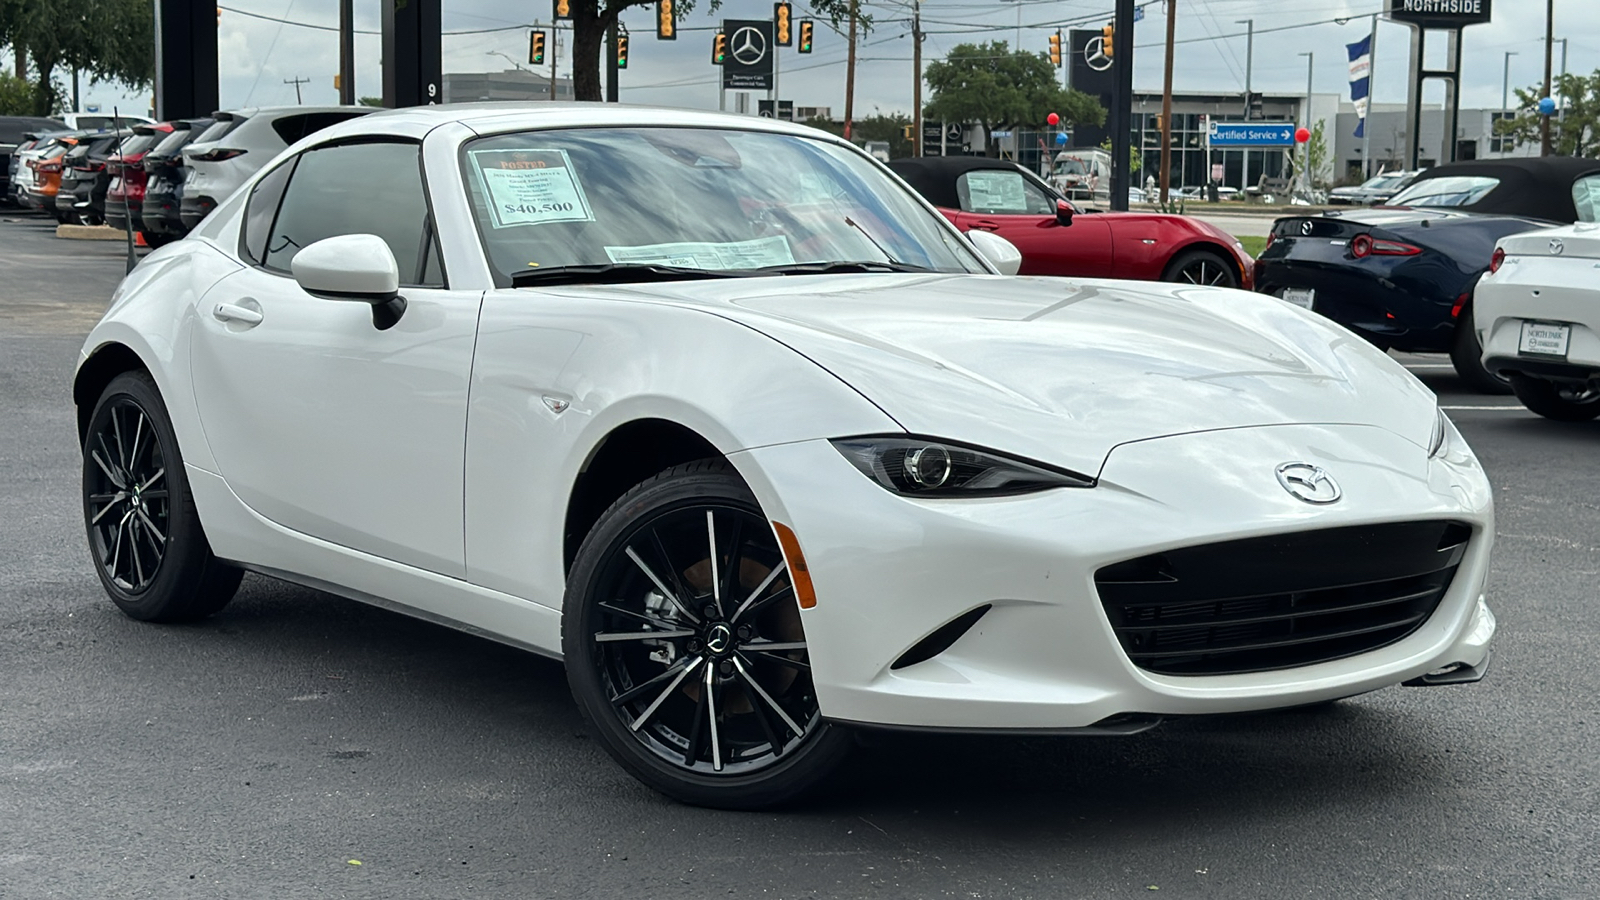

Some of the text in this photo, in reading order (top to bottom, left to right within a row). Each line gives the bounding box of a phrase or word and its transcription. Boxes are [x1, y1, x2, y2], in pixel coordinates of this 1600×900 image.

[1404, 0, 1481, 13] NORTHSIDE
[428, 83, 437, 97] 9
[1248, 131, 1277, 139] Service
[501, 161, 546, 169] POSTED
[505, 202, 573, 213] $40,500
[1527, 330, 1548, 339] NORTH
